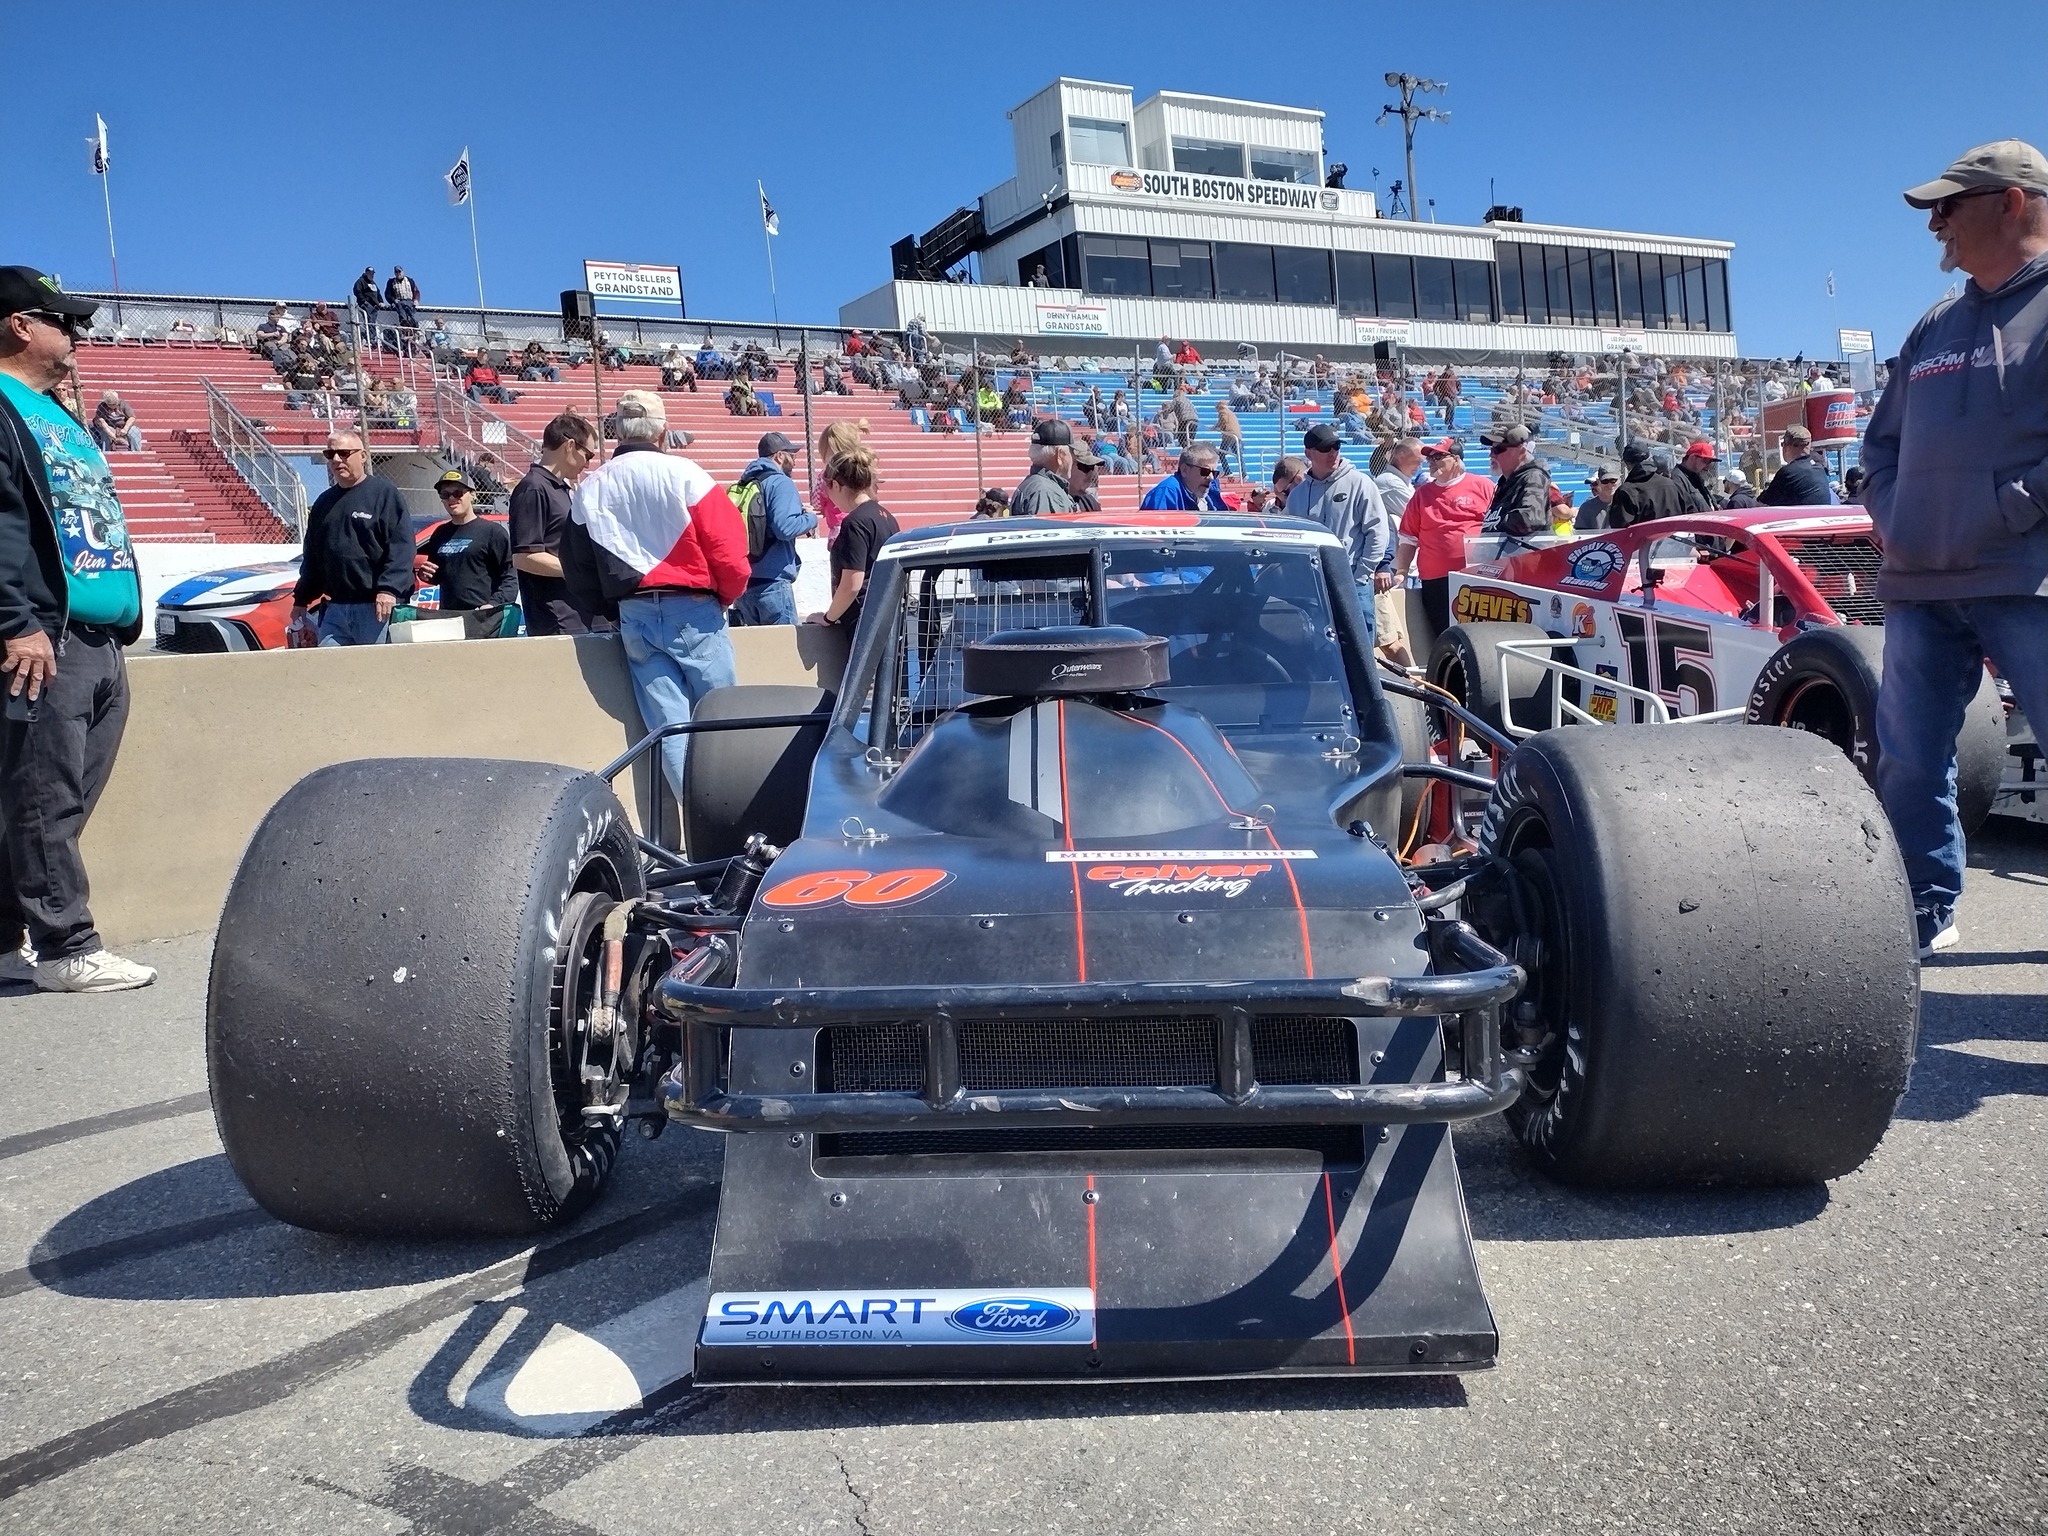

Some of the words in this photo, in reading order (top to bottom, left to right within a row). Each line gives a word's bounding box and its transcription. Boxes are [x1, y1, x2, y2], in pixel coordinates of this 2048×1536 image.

[1143, 173, 1189, 197] SOUTH
[1192, 178, 1245, 203] BOSTON
[1247, 184, 1317, 209] SPEEDWAY
[594, 271, 633, 282] PEYTON
[635, 274, 672, 284] SELLERS
[595, 283, 674, 296] GRANDSTAND
[1045, 321, 1103, 331] GRANDSTAND
[1046, 312, 1070, 320] DENNY
[1071, 313, 1099, 321] HAMLIN
[986, 531, 1060, 544] pace
[1112, 528, 1196, 536] matic
[73, 550, 107, 576] Jim
[1567, 541, 1605, 563] Shady
[1560, 575, 1609, 590] Racing
[1457, 587, 1528, 623] STEVE'S
[1612, 607, 1718, 723] 15
[1748, 652, 1793, 722] oosier
[759, 867, 953, 909] 60
[1108, 875, 1253, 898] Trucking
[718, 1298, 937, 1326] SMART
[975, 1302, 1049, 1330] Ford
[745, 1329, 803, 1340] SOUTH
[881, 1329, 904, 1340] VA
